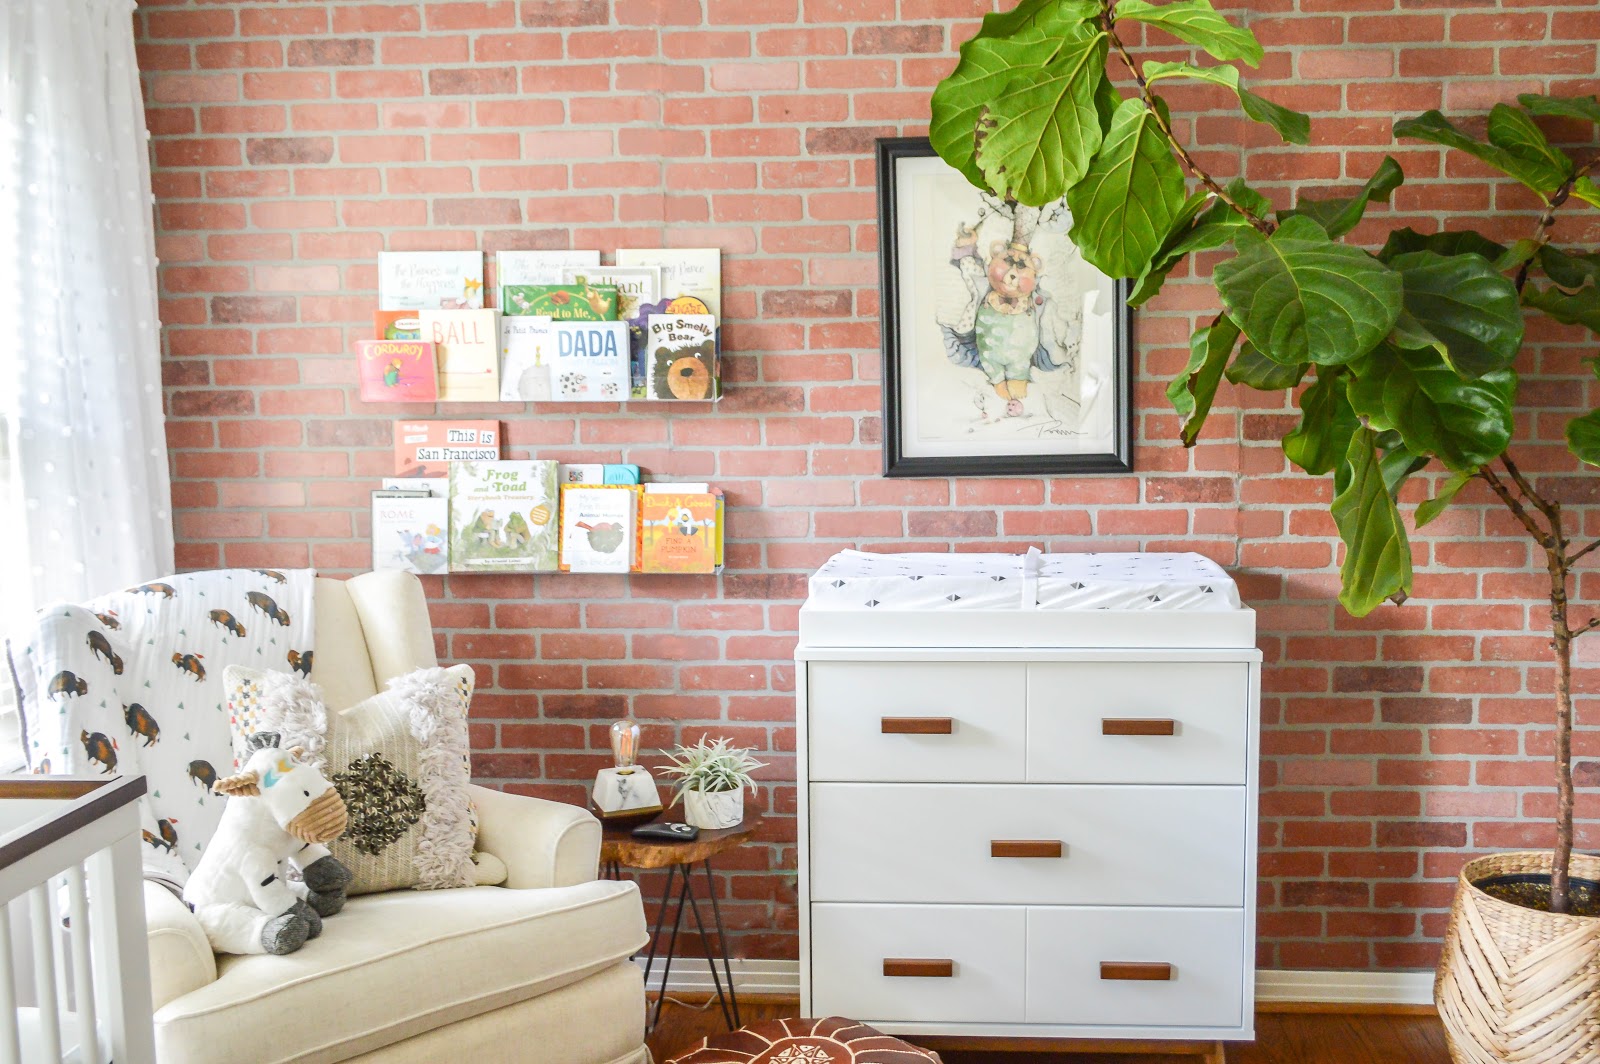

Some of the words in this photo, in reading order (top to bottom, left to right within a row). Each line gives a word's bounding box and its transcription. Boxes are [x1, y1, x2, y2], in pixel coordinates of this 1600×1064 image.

[536, 308, 559, 318] Read
[561, 309, 571, 318] to
[573, 308, 591, 319] Me,
[432, 321, 485, 345] BALL
[652, 322, 673, 334] Big
[676, 319, 713, 337] Smelly
[558, 330, 618, 357] DADA
[668, 333, 695, 342] Bear
[364, 343, 423, 361] CORDUROY
[449, 430, 475, 442] This
[481, 432, 492, 444] is
[418, 448, 439, 460] San
[443, 448, 496, 460] Francisco
[482, 469, 519, 482] Frog
[492, 481, 527, 492] Toad
[379, 510, 415, 519] ROME
